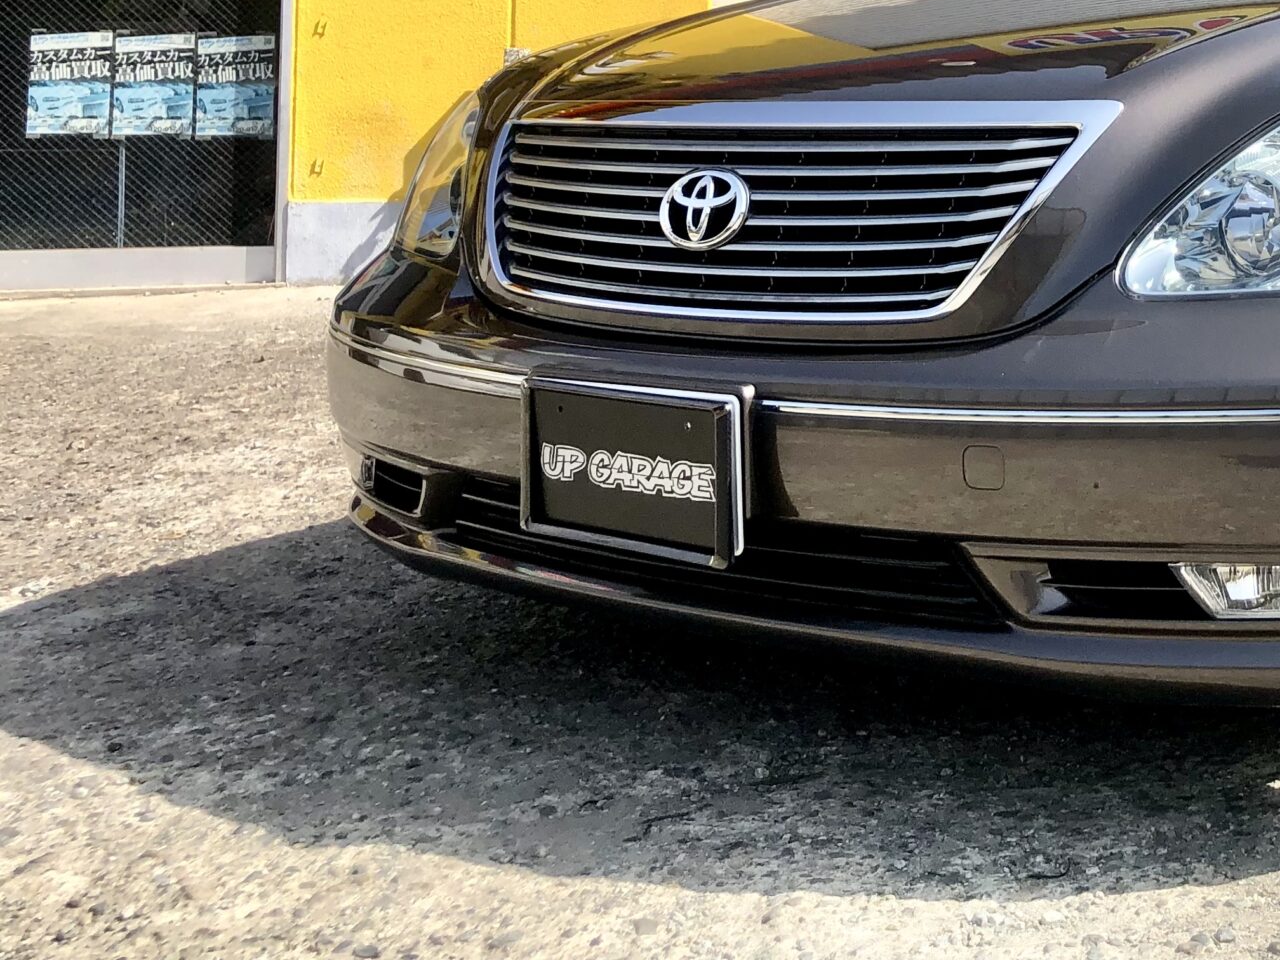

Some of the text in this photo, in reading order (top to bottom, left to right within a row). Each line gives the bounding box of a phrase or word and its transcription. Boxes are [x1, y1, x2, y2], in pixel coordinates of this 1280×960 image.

[30, 47, 111, 62] カスタムカー
[115, 49, 193, 65] カスタムカー
[198, 50, 273, 66] カスタムカー
[541, 442, 716, 502] UP GARAGE
